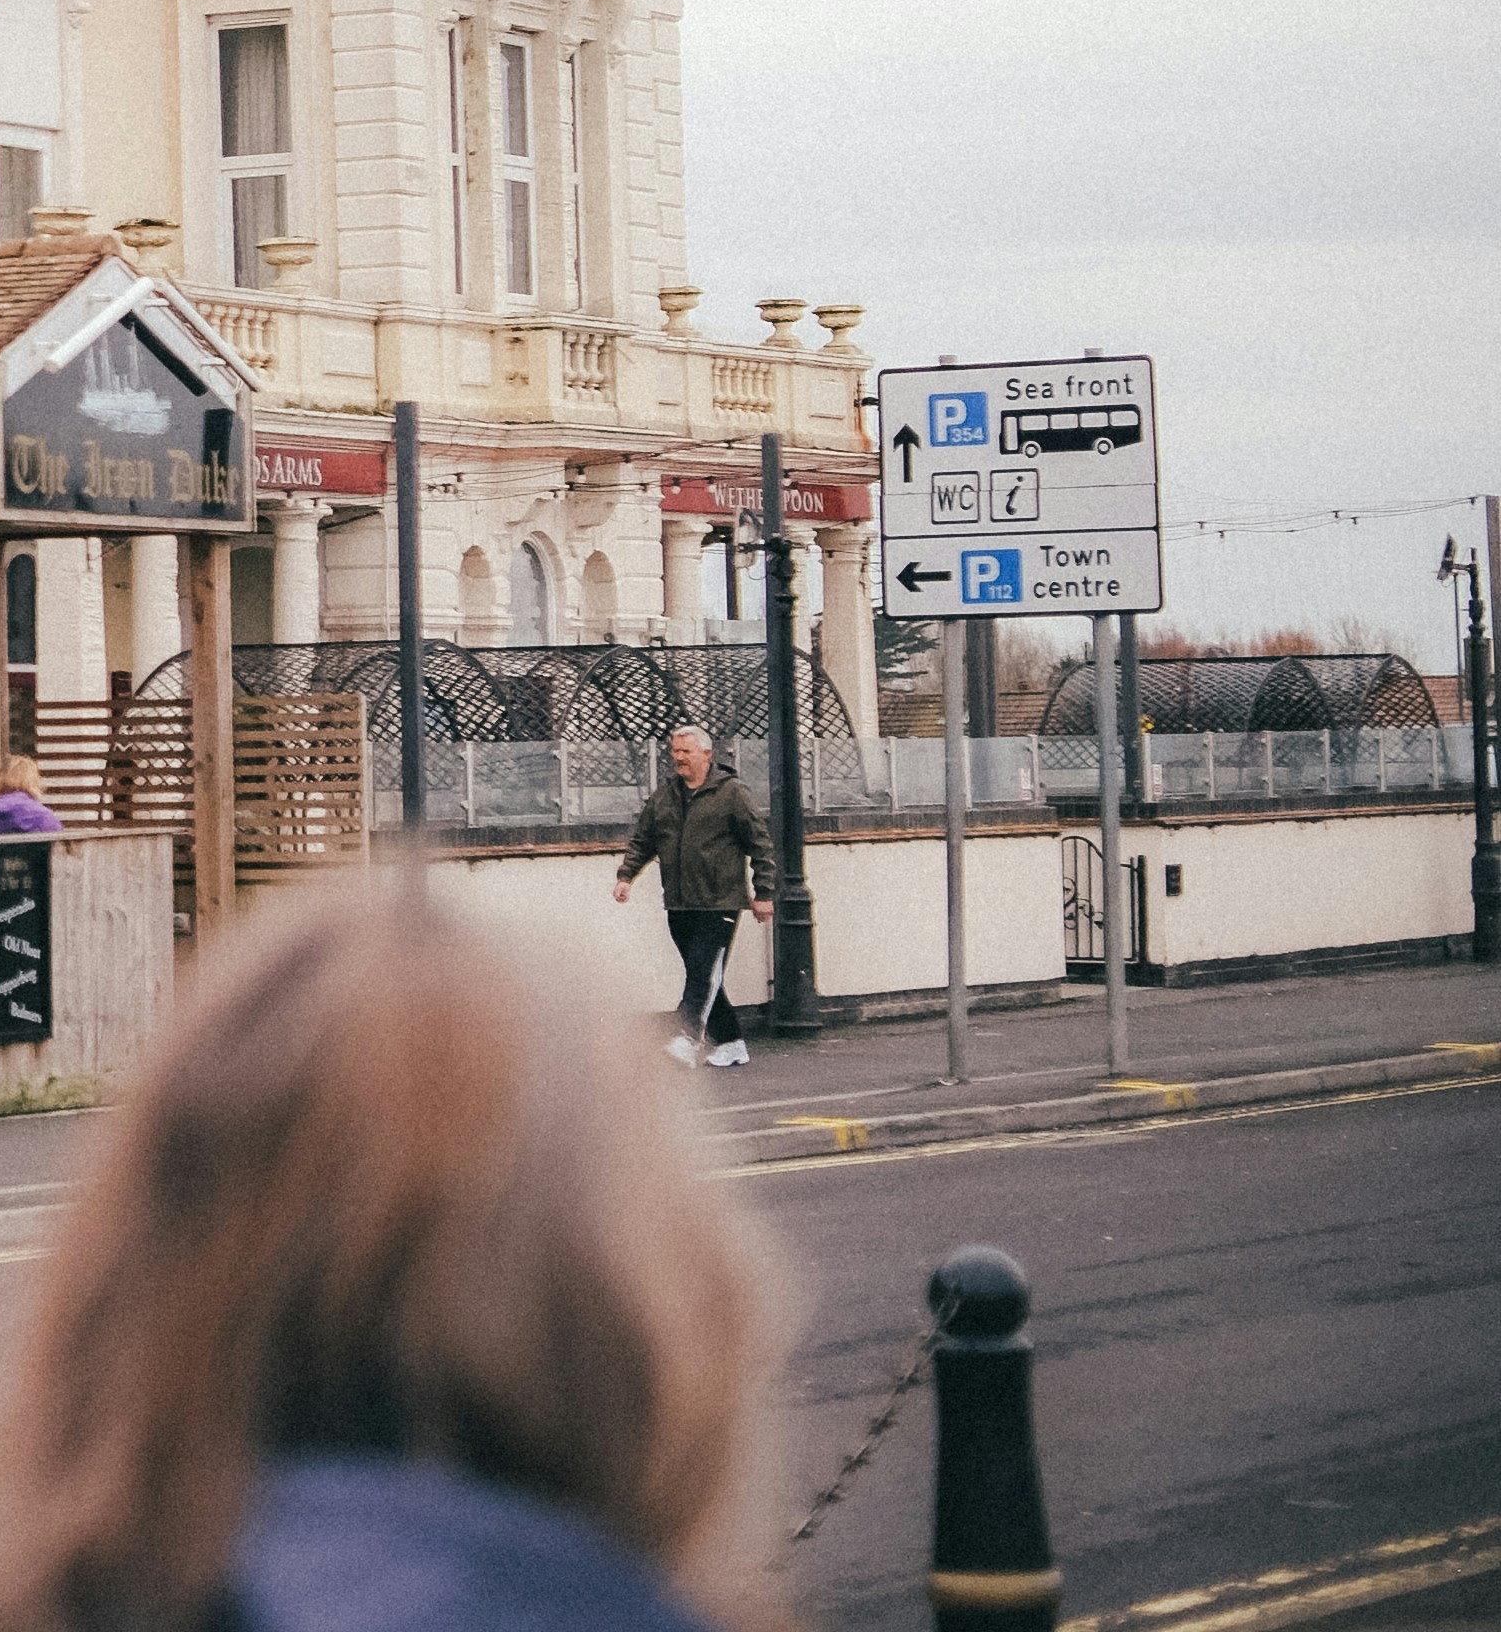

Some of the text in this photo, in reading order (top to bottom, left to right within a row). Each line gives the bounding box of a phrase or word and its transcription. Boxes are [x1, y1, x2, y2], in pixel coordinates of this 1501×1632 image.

[1005, 373, 1134, 401] Sea front
[934, 399, 984, 443] P 354
[12, 434, 71, 501] The
[166, 448, 242, 506] Duke
[271, 453, 323, 486] ARMS
[713, 483, 824, 514] WETHEPOON
[936, 484, 976, 511] WC
[1039, 545, 1111, 567] Town
[968, 555, 1014, 599] P 112
[1033, 576, 1121, 599] centre
